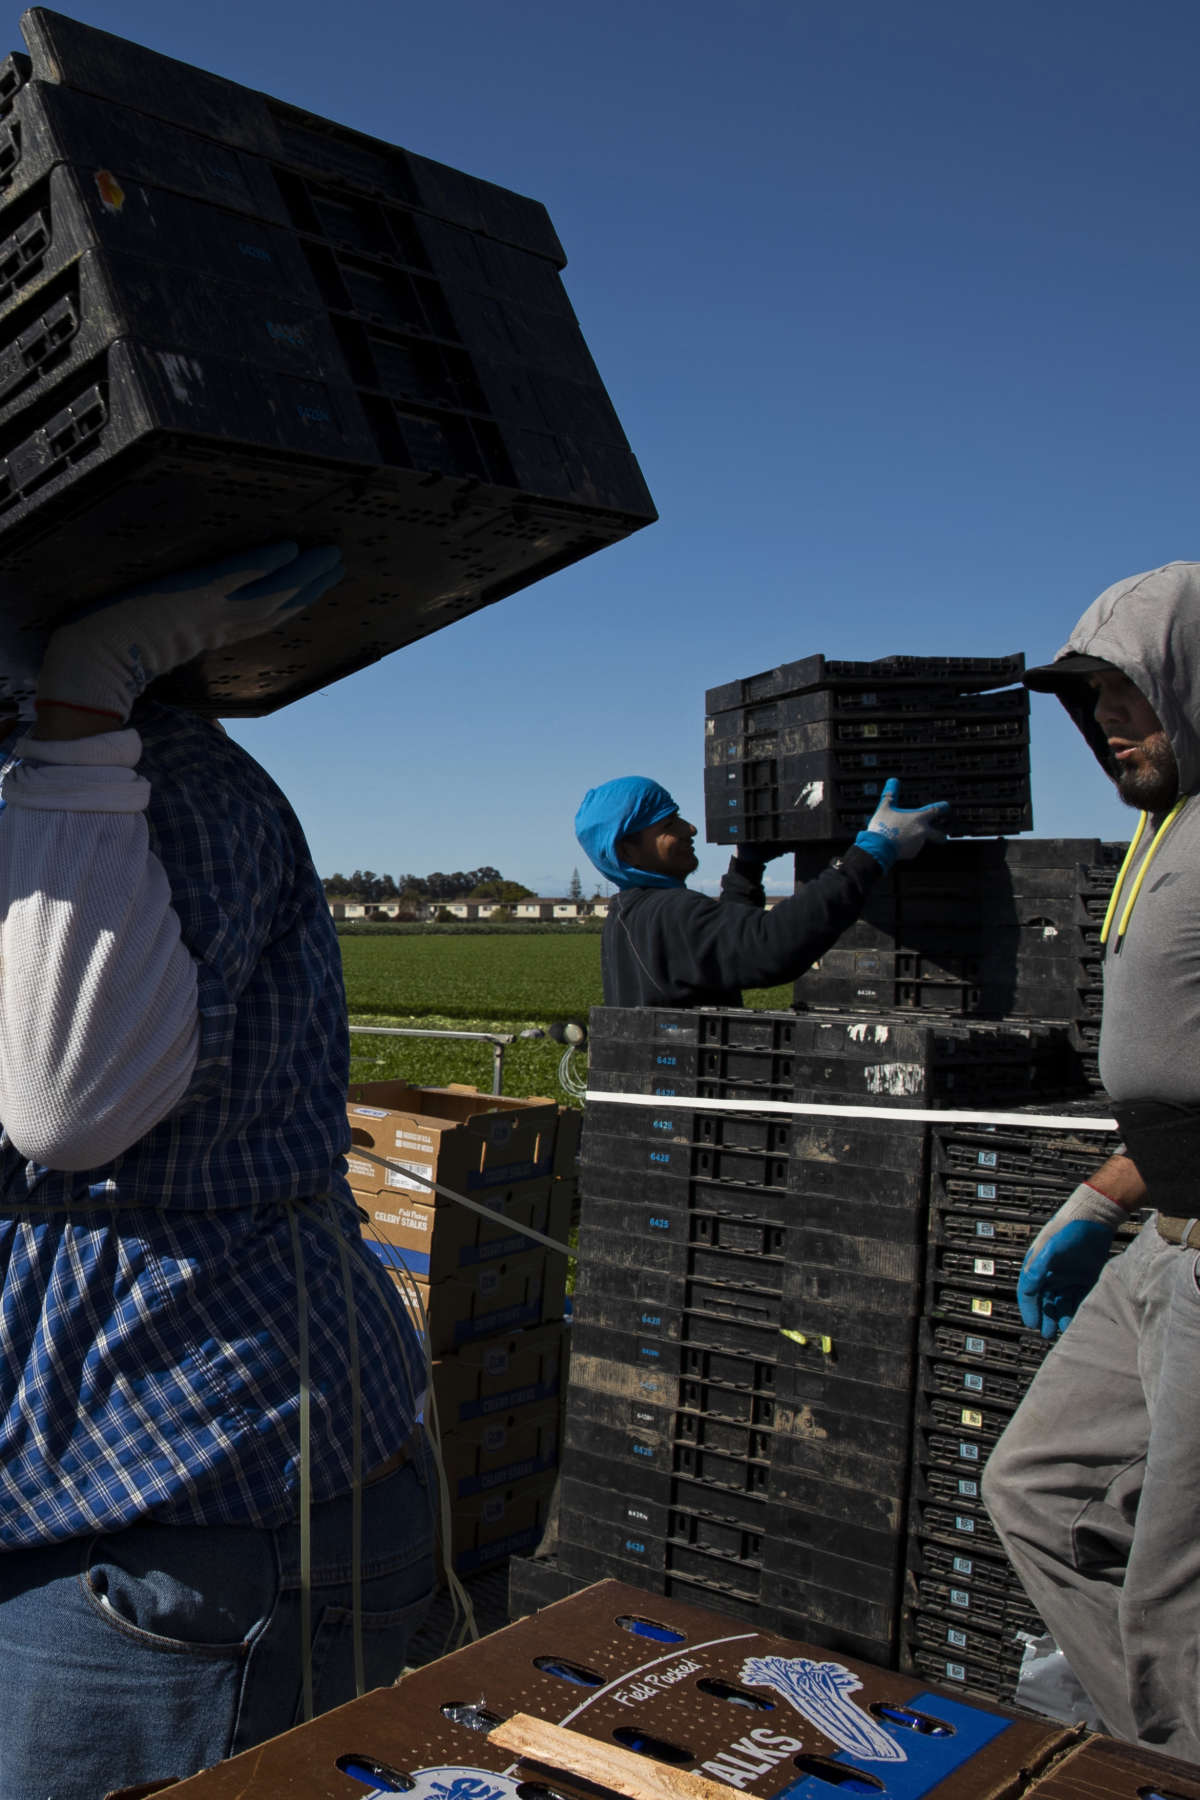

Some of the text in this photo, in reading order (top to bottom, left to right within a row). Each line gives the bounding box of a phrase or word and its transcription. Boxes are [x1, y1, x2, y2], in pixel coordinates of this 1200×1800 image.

[652, 1119, 673, 1129] 6428
[649, 1151, 671, 1163] 6428
[374, 1211, 428, 1232] CELERY STALKS
[613, 1658, 703, 1707] Field Packed
[690, 1728, 803, 1789] ALKS
